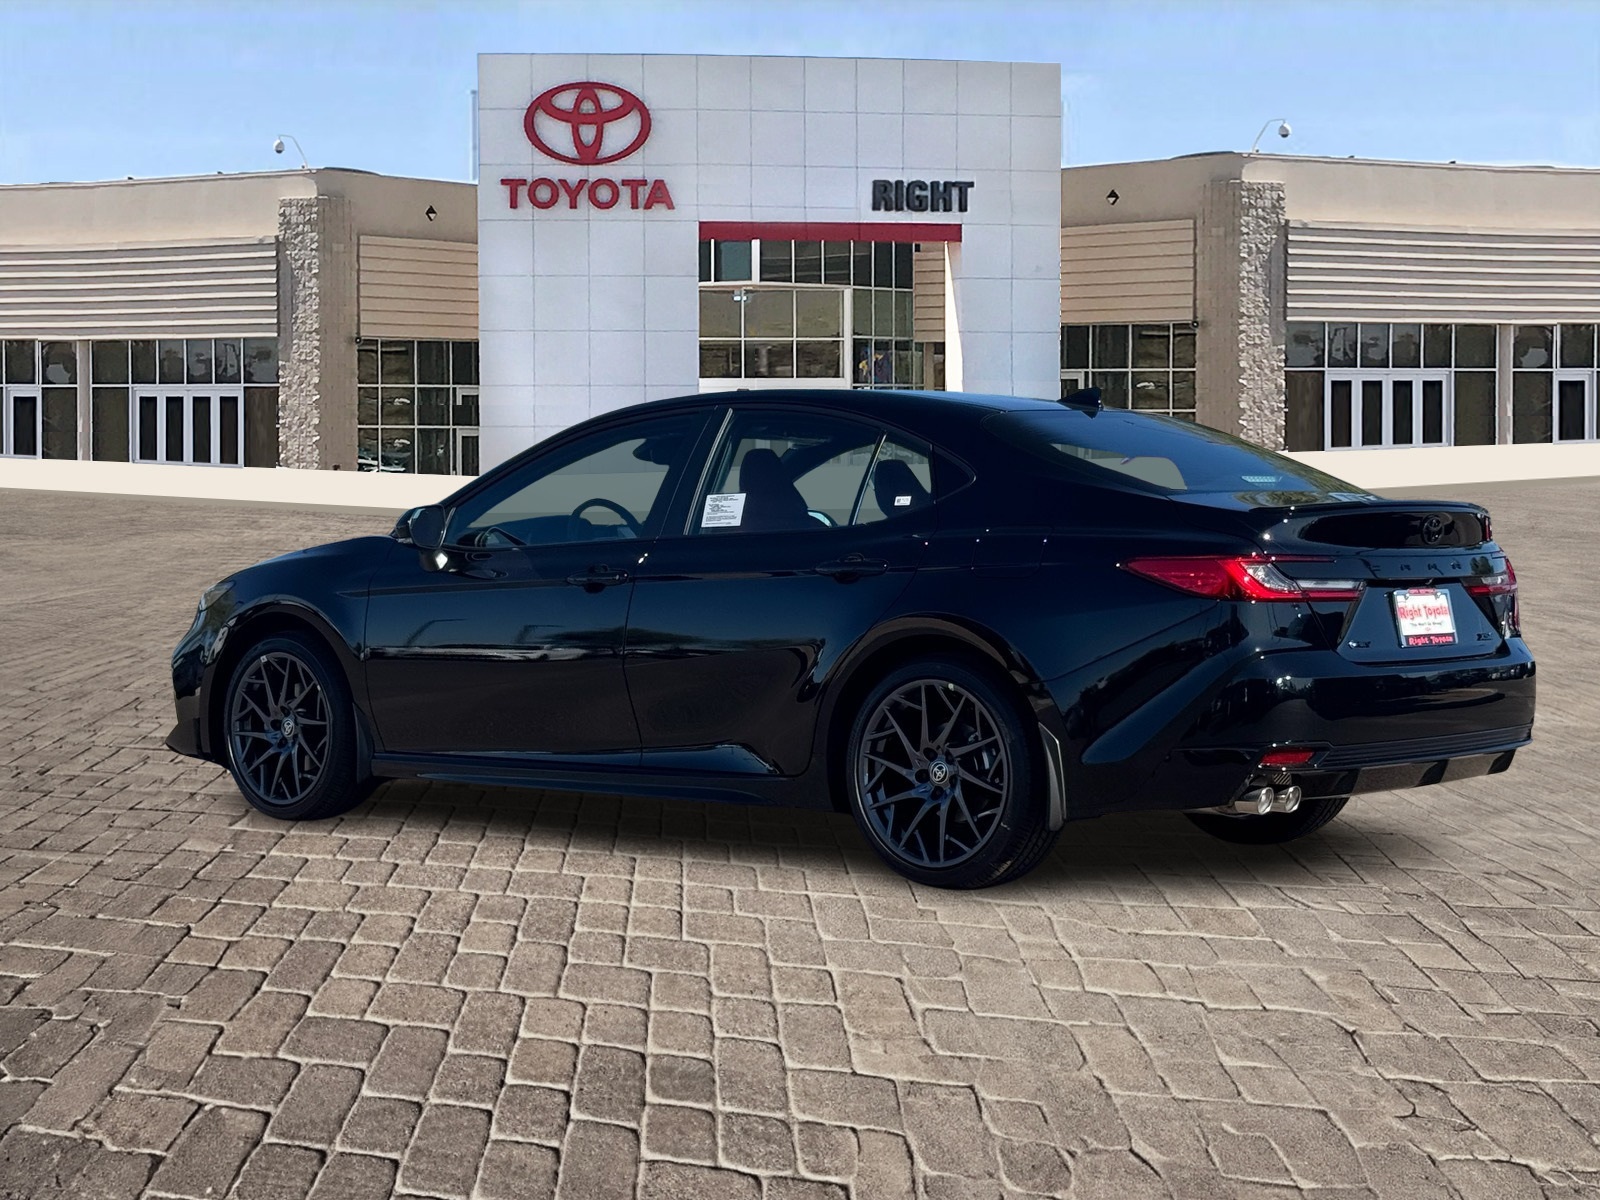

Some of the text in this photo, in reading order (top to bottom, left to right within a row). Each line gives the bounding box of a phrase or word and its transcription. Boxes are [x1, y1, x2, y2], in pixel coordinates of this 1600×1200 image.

[500, 178, 675, 210] TOYOTA
[872, 179, 975, 212] RIGHT
[1398, 604, 1448, 620] Right Toyota
